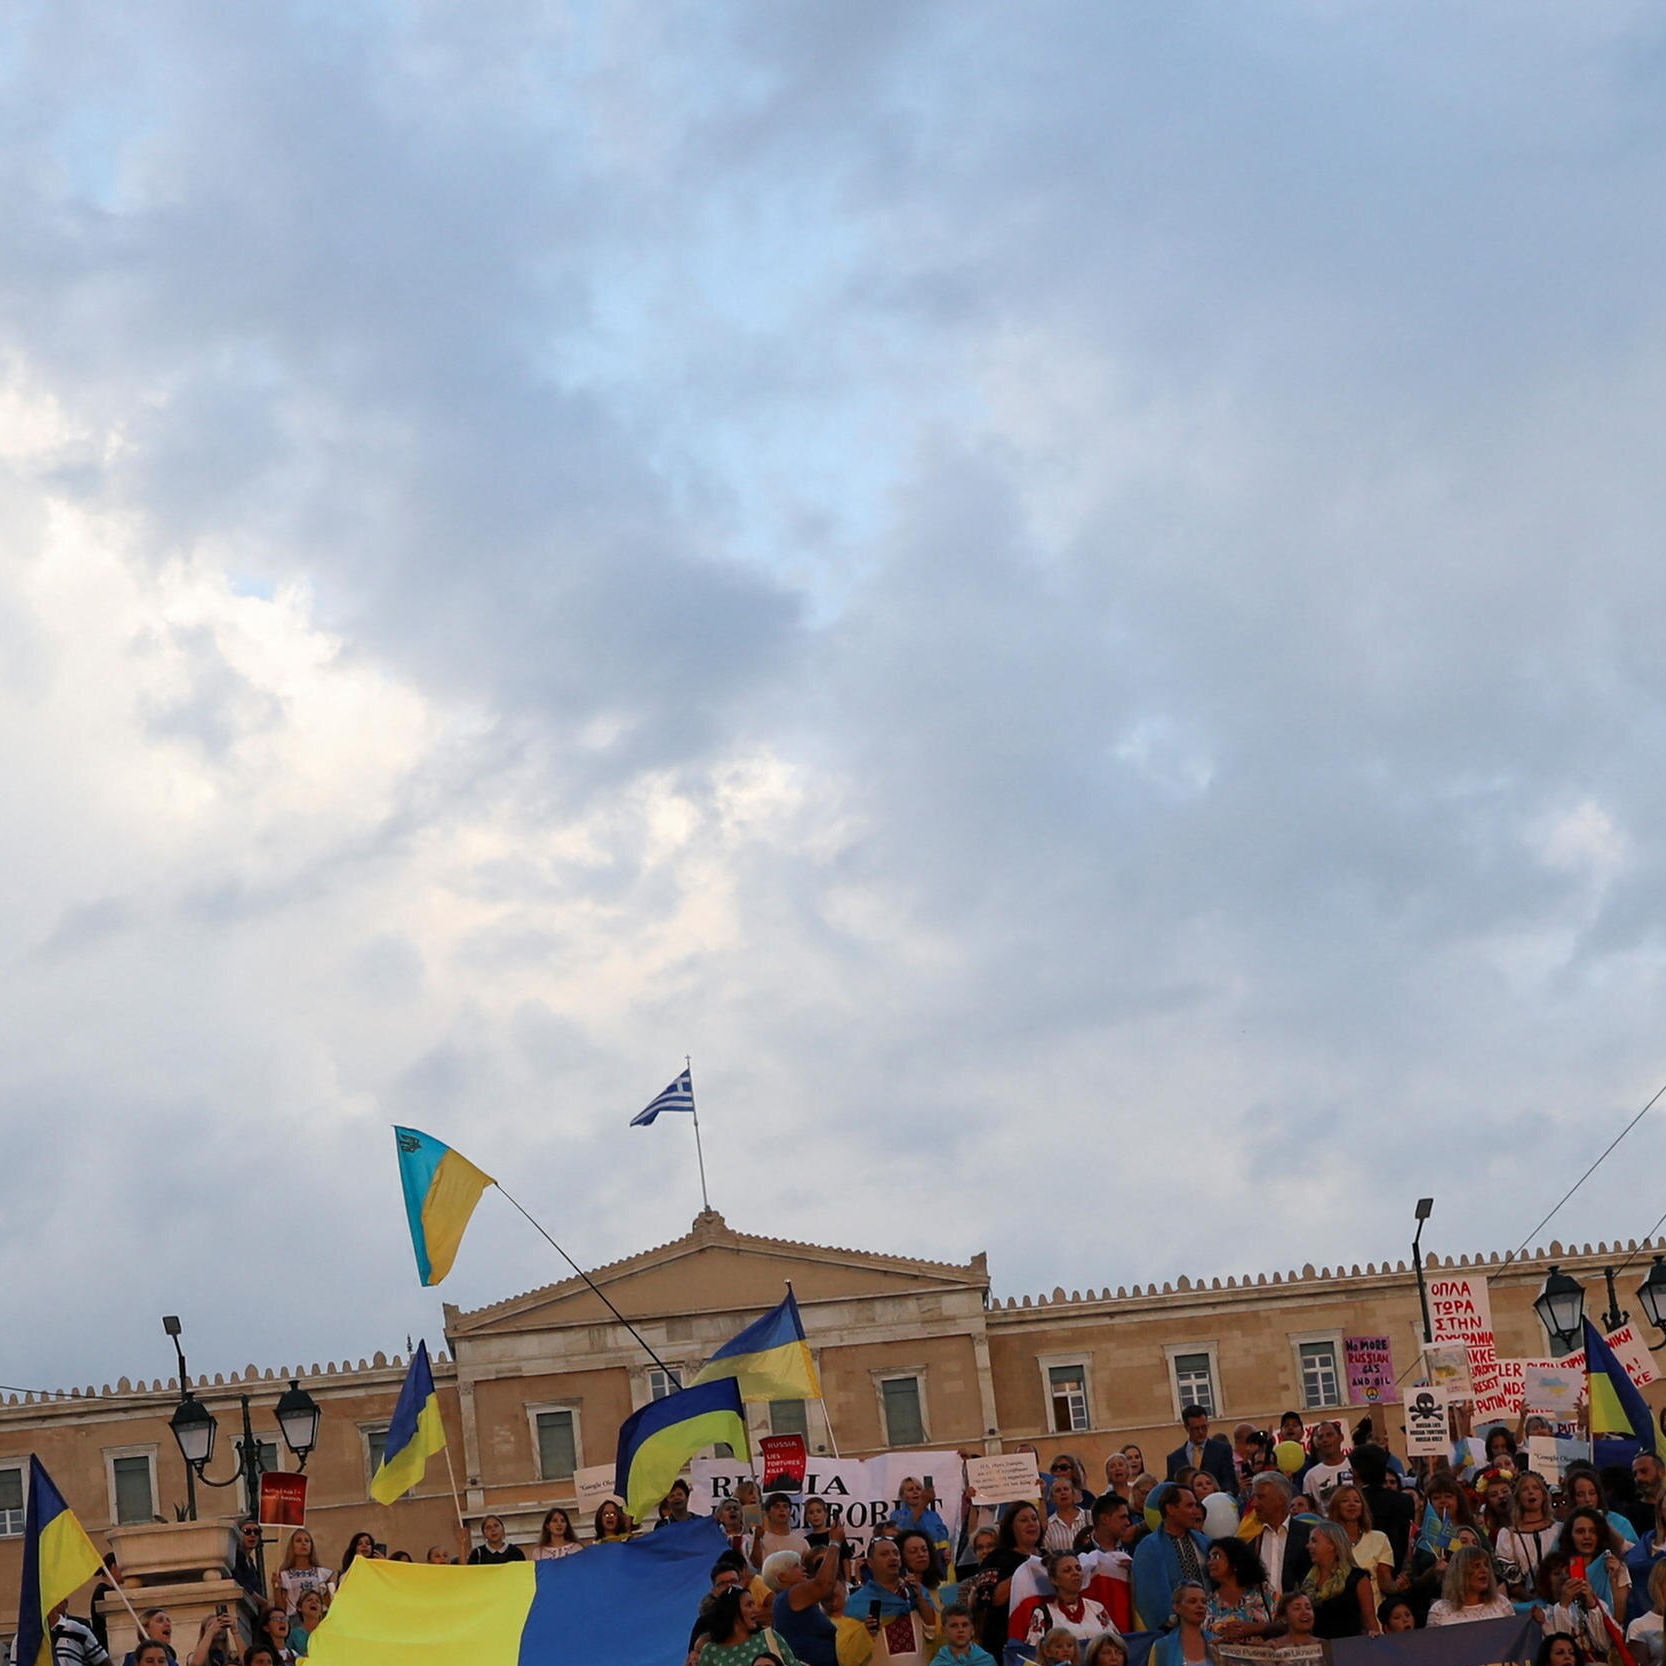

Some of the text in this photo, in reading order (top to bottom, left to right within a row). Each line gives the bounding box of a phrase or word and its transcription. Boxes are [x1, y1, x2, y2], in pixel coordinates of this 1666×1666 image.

[1435, 1316, 1482, 1331] ΣΤΗΝ
[1361, 1339, 1388, 1350] MORE
[1349, 1353, 1389, 1364] RUSSIAN
[1363, 1365, 1380, 1374] GAS
[1352, 1377, 1390, 1386] AND OIL
[767, 1440, 798, 1449] RUSSIA
